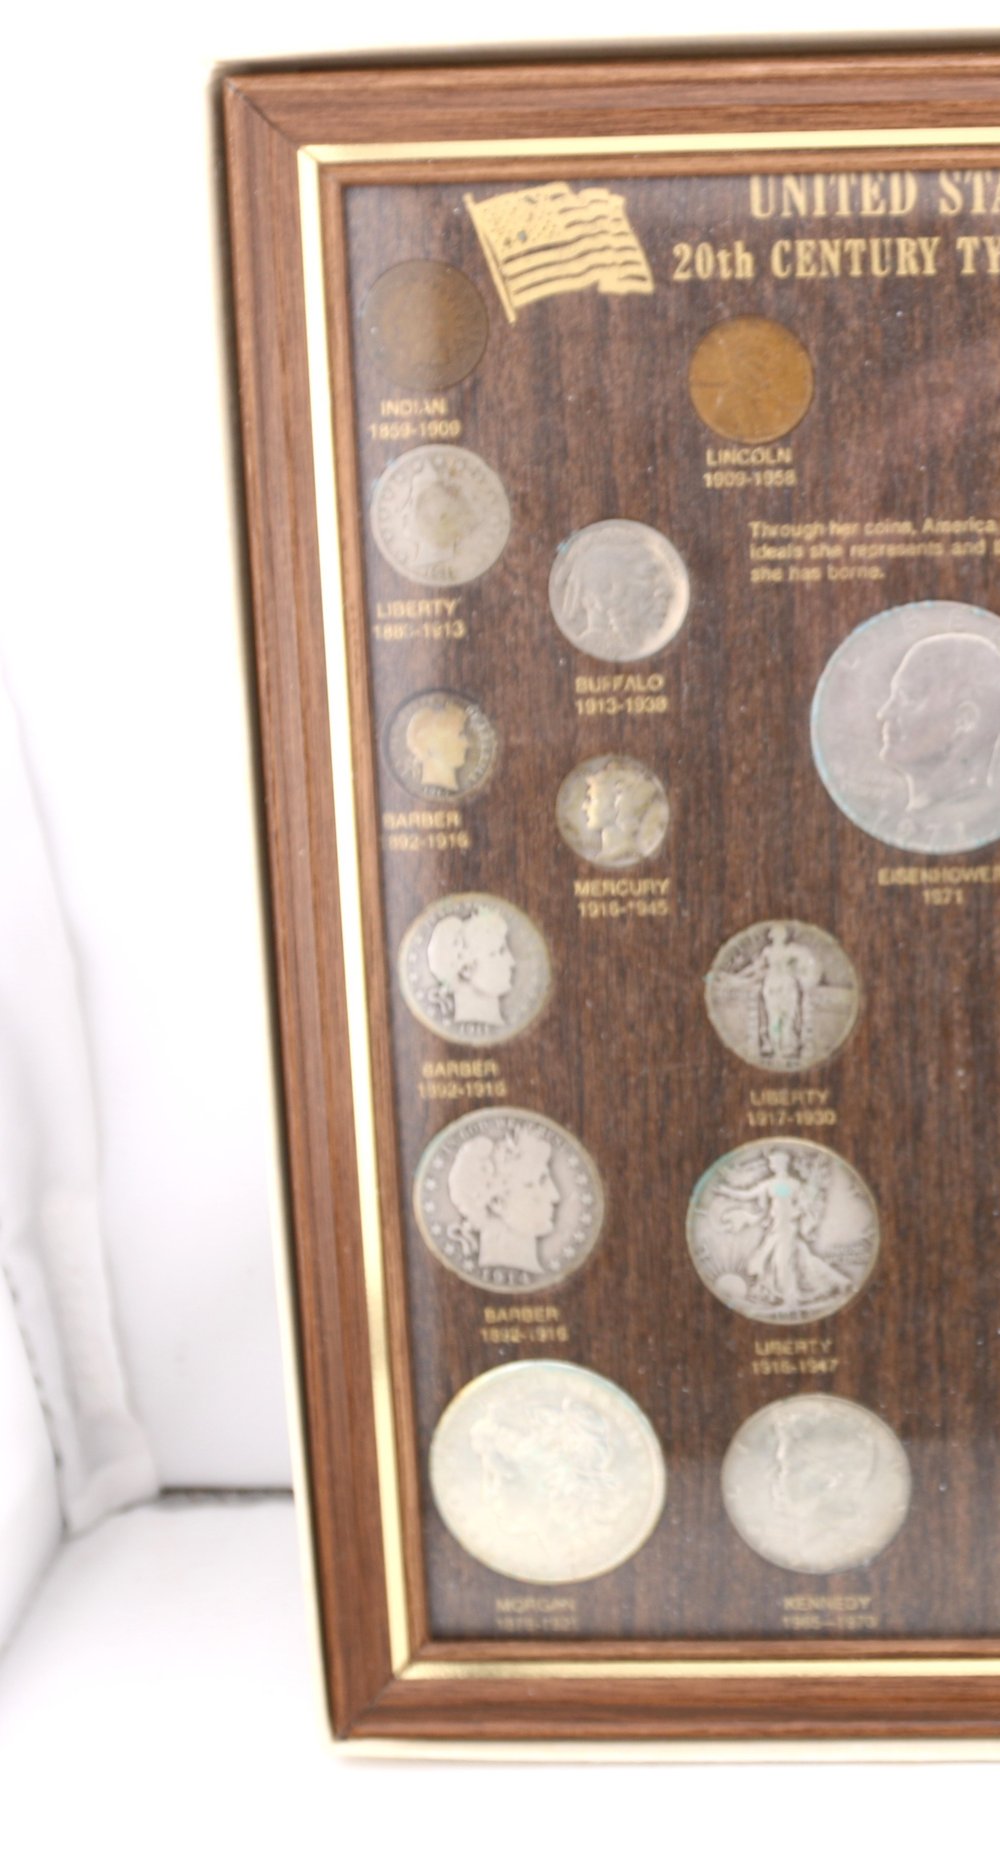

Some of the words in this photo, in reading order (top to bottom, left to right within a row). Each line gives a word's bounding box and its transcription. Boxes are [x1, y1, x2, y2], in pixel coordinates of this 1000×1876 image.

[749, 170, 918, 219] UNITED
[672, 240, 754, 280] 20th
[771, 237, 940, 278] CENTURY
[706, 447, 792, 466] LINCOLN
[376, 599, 459, 618] LIBERTY
[576, 674, 664, 694] BUFFALO
[574, 878, 670, 897] MERCURY
[750, 1088, 829, 1107] LIBERTY
[755, 1339, 833, 1356] LIBERTY
